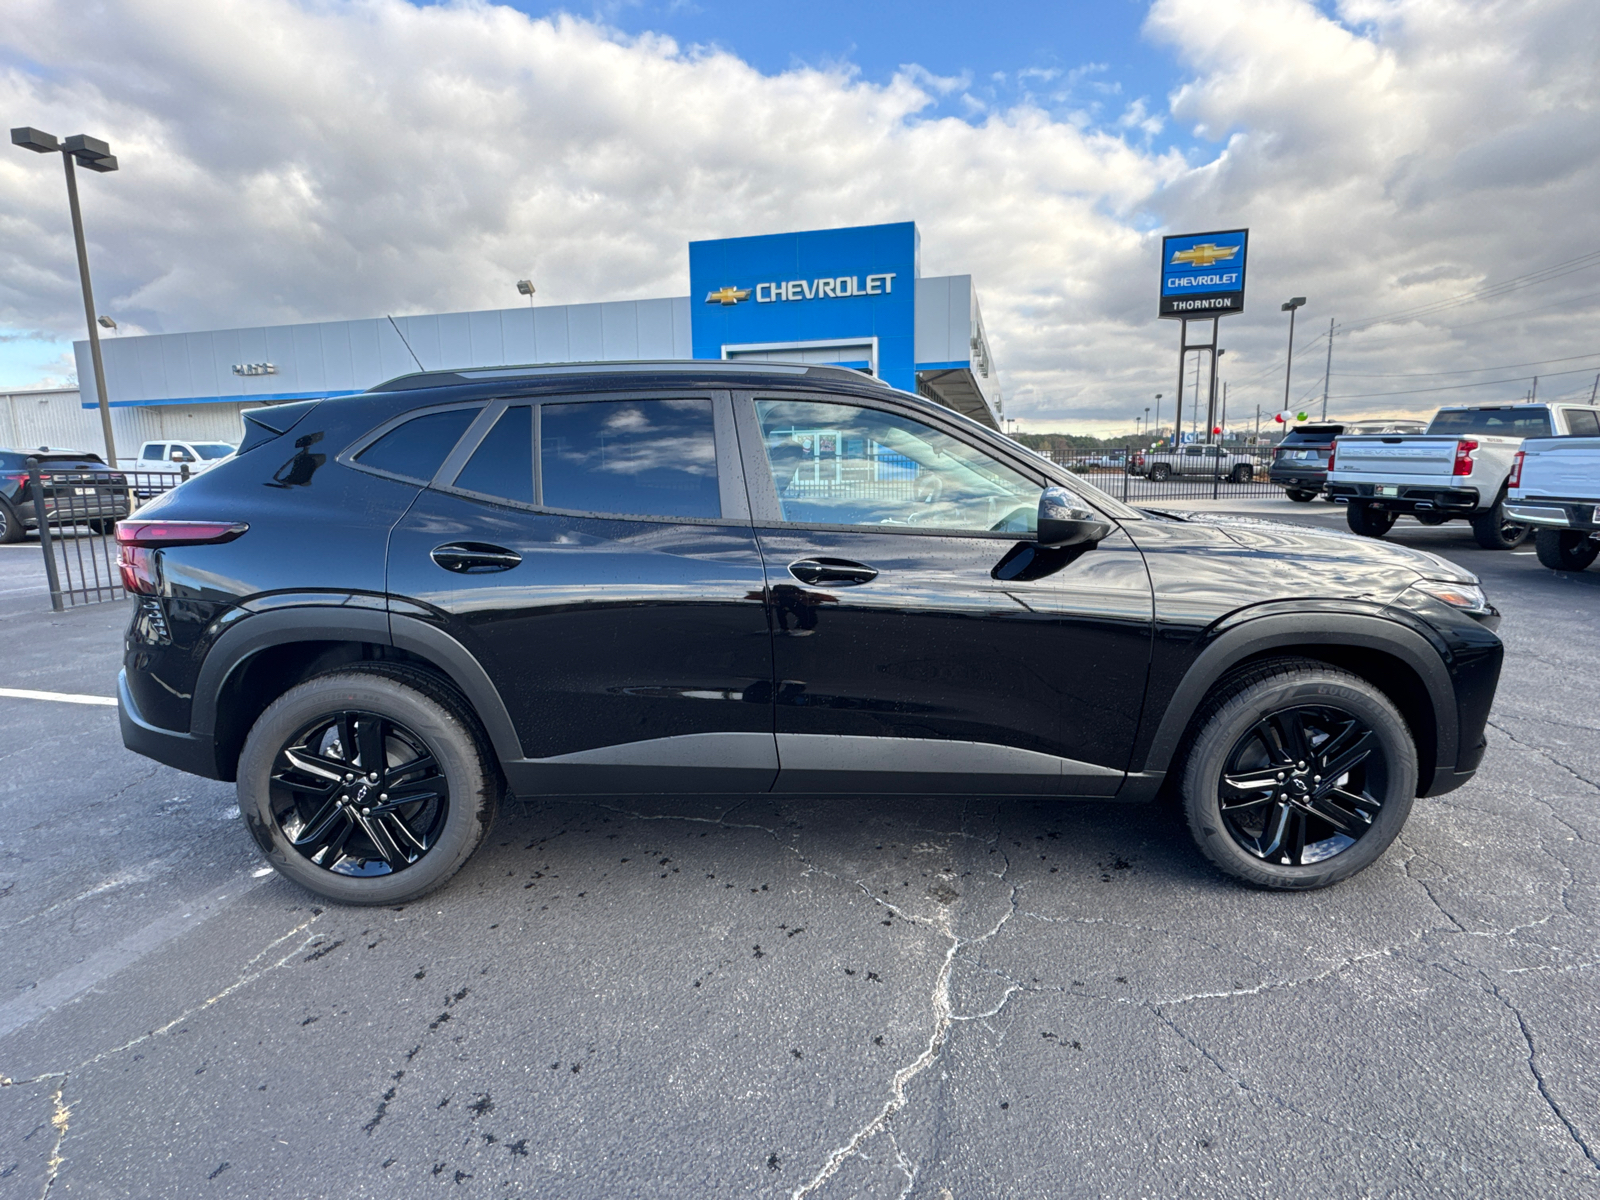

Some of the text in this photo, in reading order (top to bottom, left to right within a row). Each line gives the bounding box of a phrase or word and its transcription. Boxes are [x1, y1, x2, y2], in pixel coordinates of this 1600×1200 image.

[1168, 273, 1238, 288] CHEVROLET
[756, 273, 896, 303] CHEVROLET
[1172, 298, 1232, 310] THORNTON
[231, 362, 275, 376] PARTS
